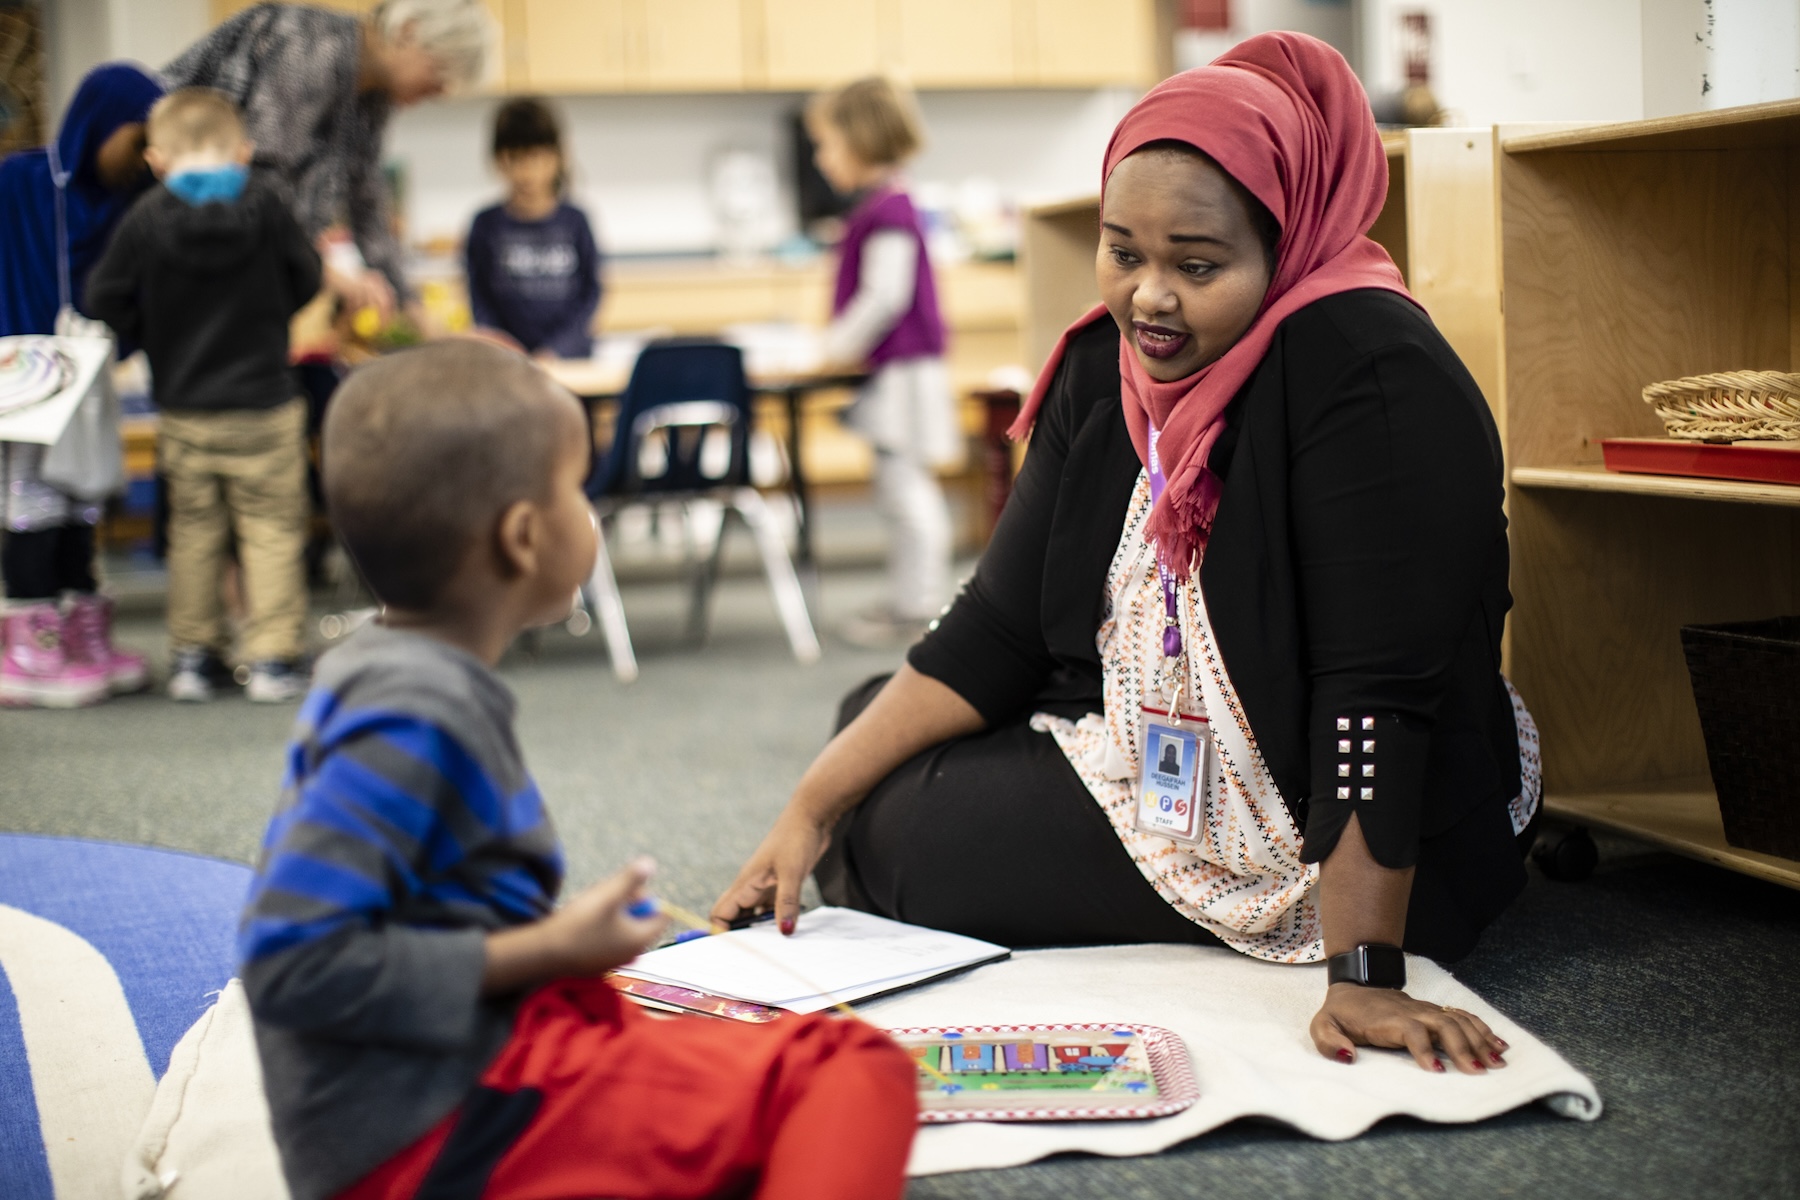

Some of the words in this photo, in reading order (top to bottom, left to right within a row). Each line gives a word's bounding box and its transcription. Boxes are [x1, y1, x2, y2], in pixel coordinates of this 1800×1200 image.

[1151, 427, 1161, 475] homas
[1156, 780, 1180, 790] HUSSEIN
[1162, 797, 1170, 810] P
[1177, 800, 1186, 814] S
[1155, 816, 1173, 825] STAFF
